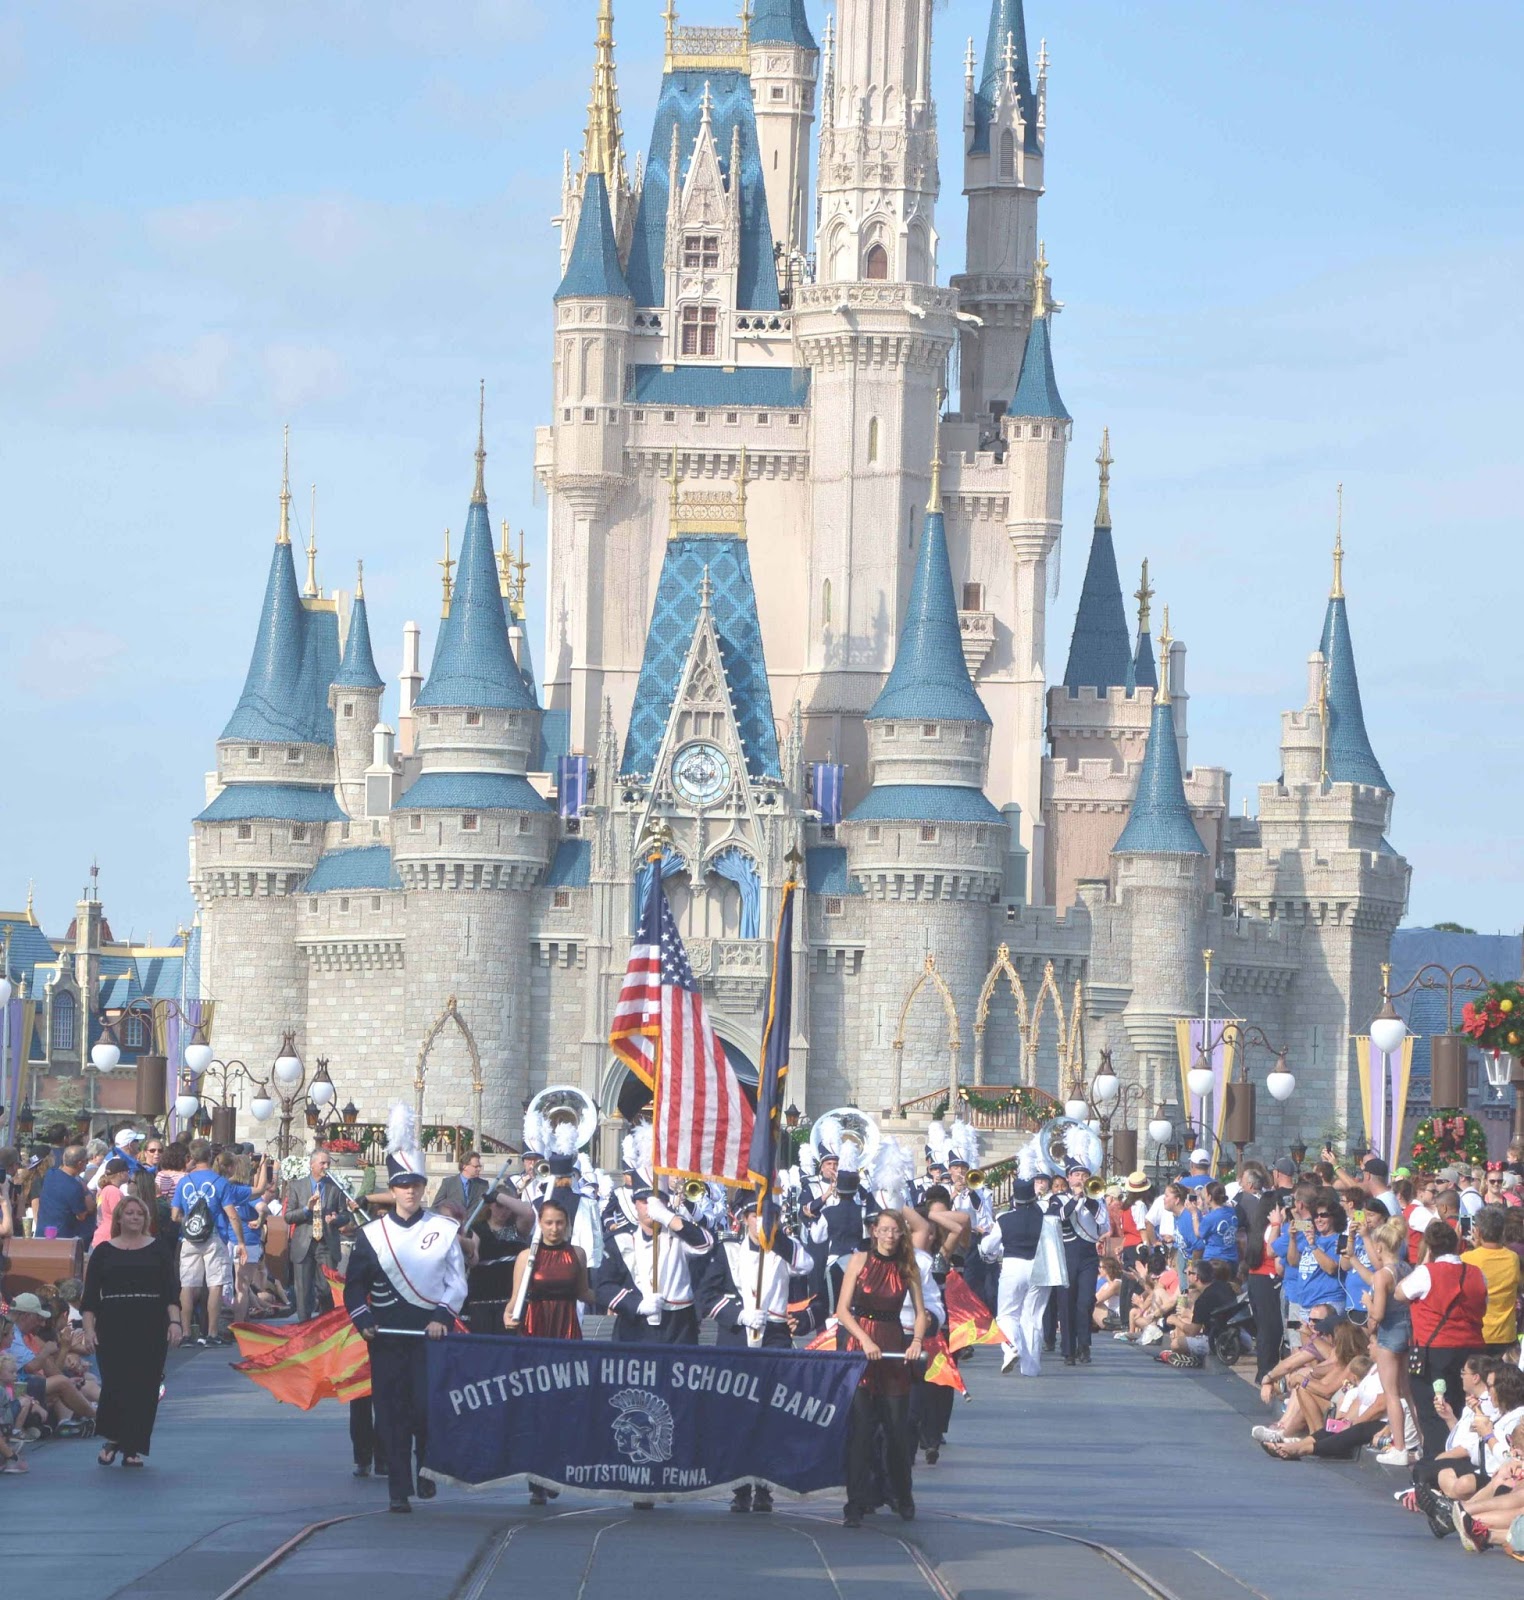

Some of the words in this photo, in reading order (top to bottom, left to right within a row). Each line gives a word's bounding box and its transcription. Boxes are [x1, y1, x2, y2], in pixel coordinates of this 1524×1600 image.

[420, 1231, 440, 1251] P
[449, 1360, 590, 1415] POTTSTOWN
[601, 1359, 656, 1387] HIGH
[671, 1362, 760, 1403] SCHOOL
[770, 1383, 836, 1428] BAND
[662, 1467, 712, 1486] PENNA.
